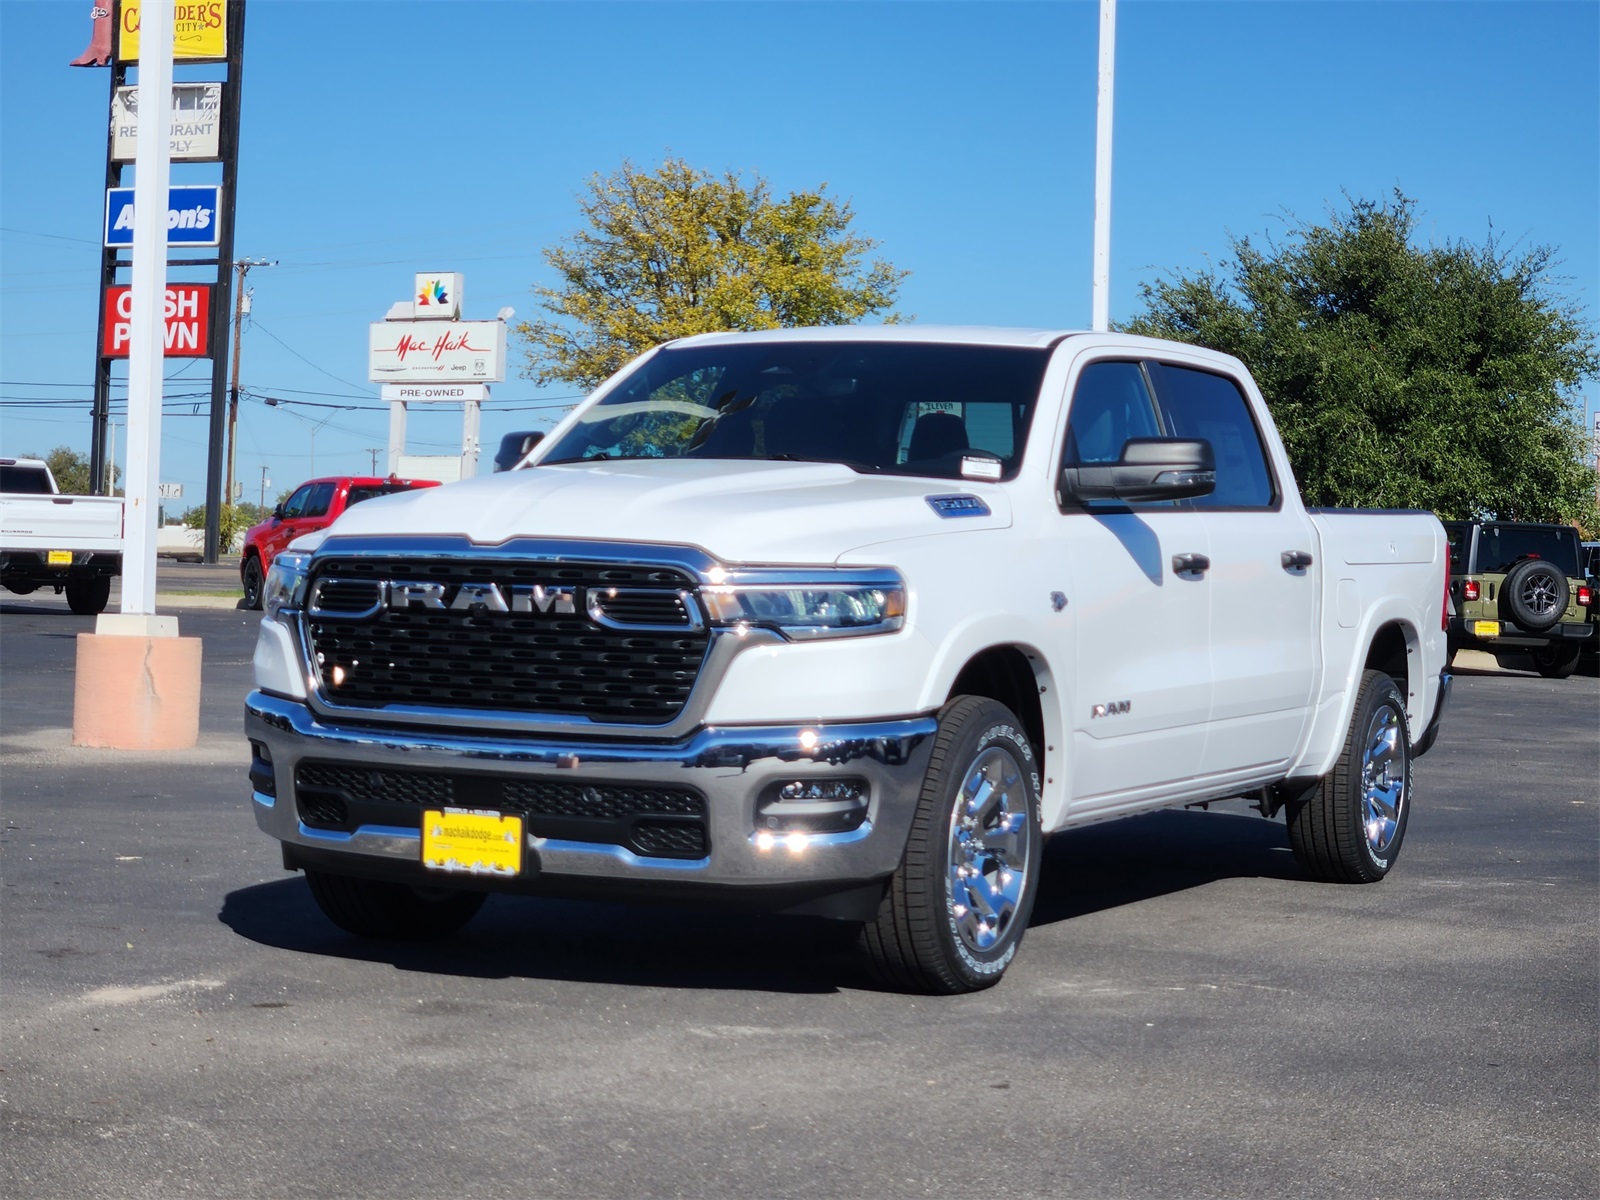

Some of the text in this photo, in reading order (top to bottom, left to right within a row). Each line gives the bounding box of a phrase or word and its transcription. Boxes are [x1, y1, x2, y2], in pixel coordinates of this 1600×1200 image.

[124, 2, 222, 33] CDER'S
[176, 22, 198, 32] CITY
[120, 123, 213, 137] RERANT
[113, 204, 211, 230] Aon's
[116, 290, 198, 319] CSH
[113, 322, 198, 349] PWN
[396, 330, 473, 361] Mac Haik
[400, 389, 464, 397] PRE-OWNED
[390, 580, 576, 614] RAM
[1091, 700, 1131, 719] RAM
